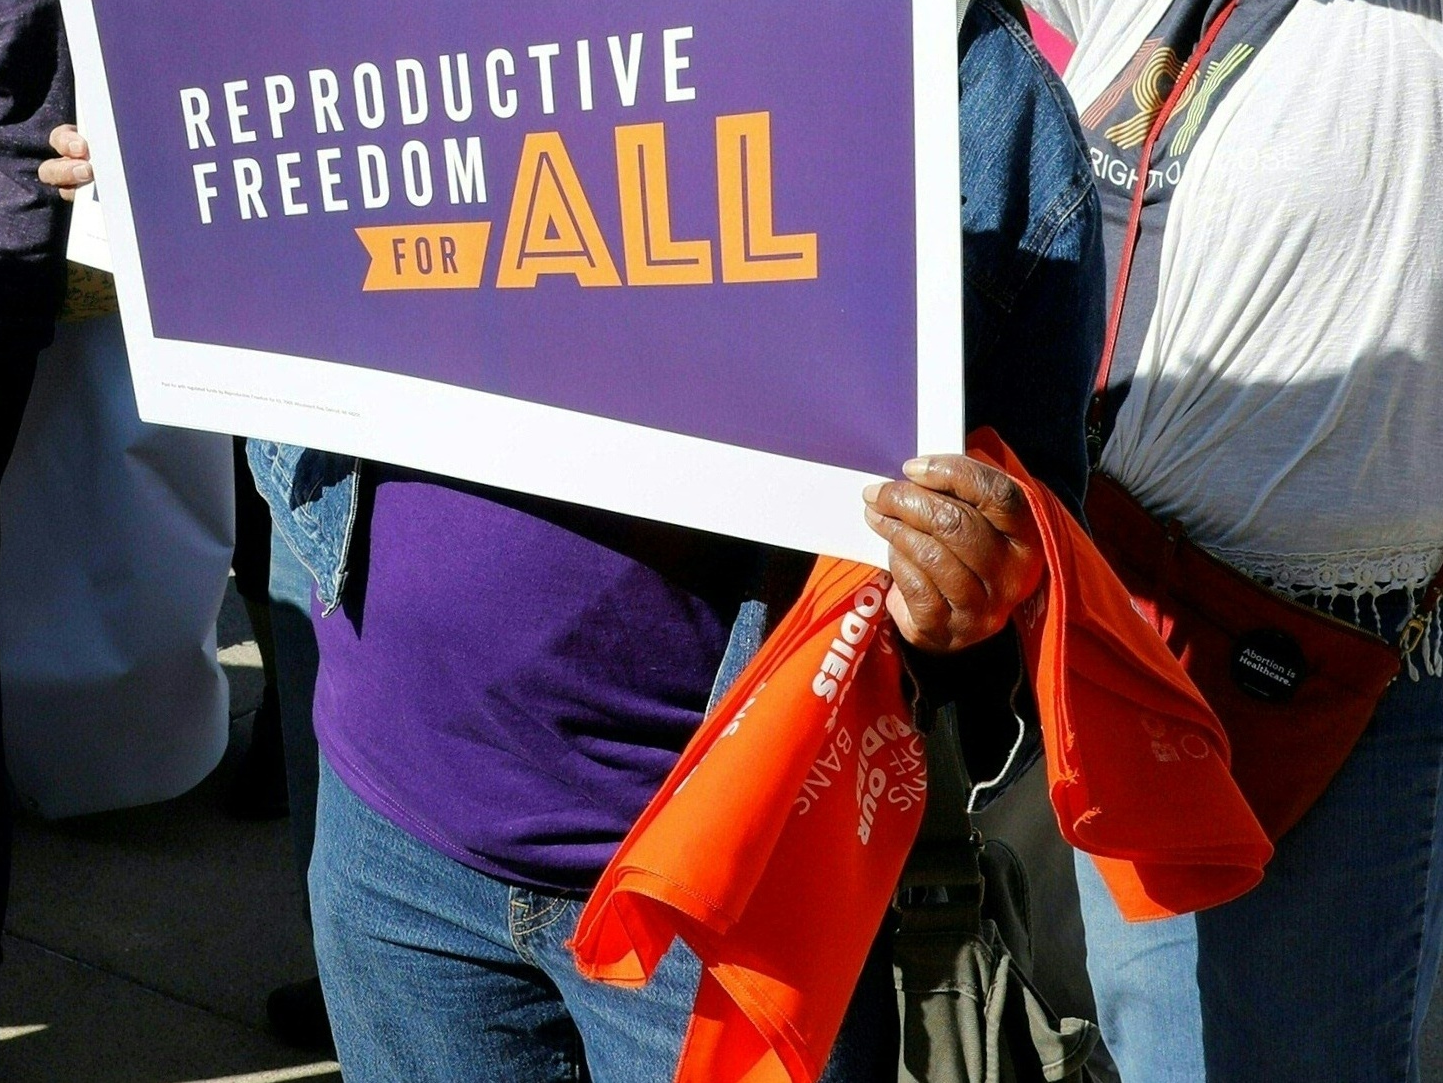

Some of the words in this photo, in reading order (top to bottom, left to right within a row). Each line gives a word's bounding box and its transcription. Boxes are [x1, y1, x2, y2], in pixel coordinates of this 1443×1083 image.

[179, 24, 697, 151] REPRODUCTIVE
[191, 134, 488, 225] FREEDOM
[391, 234, 460, 276] FOR
[494, 110, 819, 290] ALL
[1239, 655, 1292, 687] Healthcare.
[1242, 648, 1285, 674] Abortion
[1286, 668, 1297, 679] is
